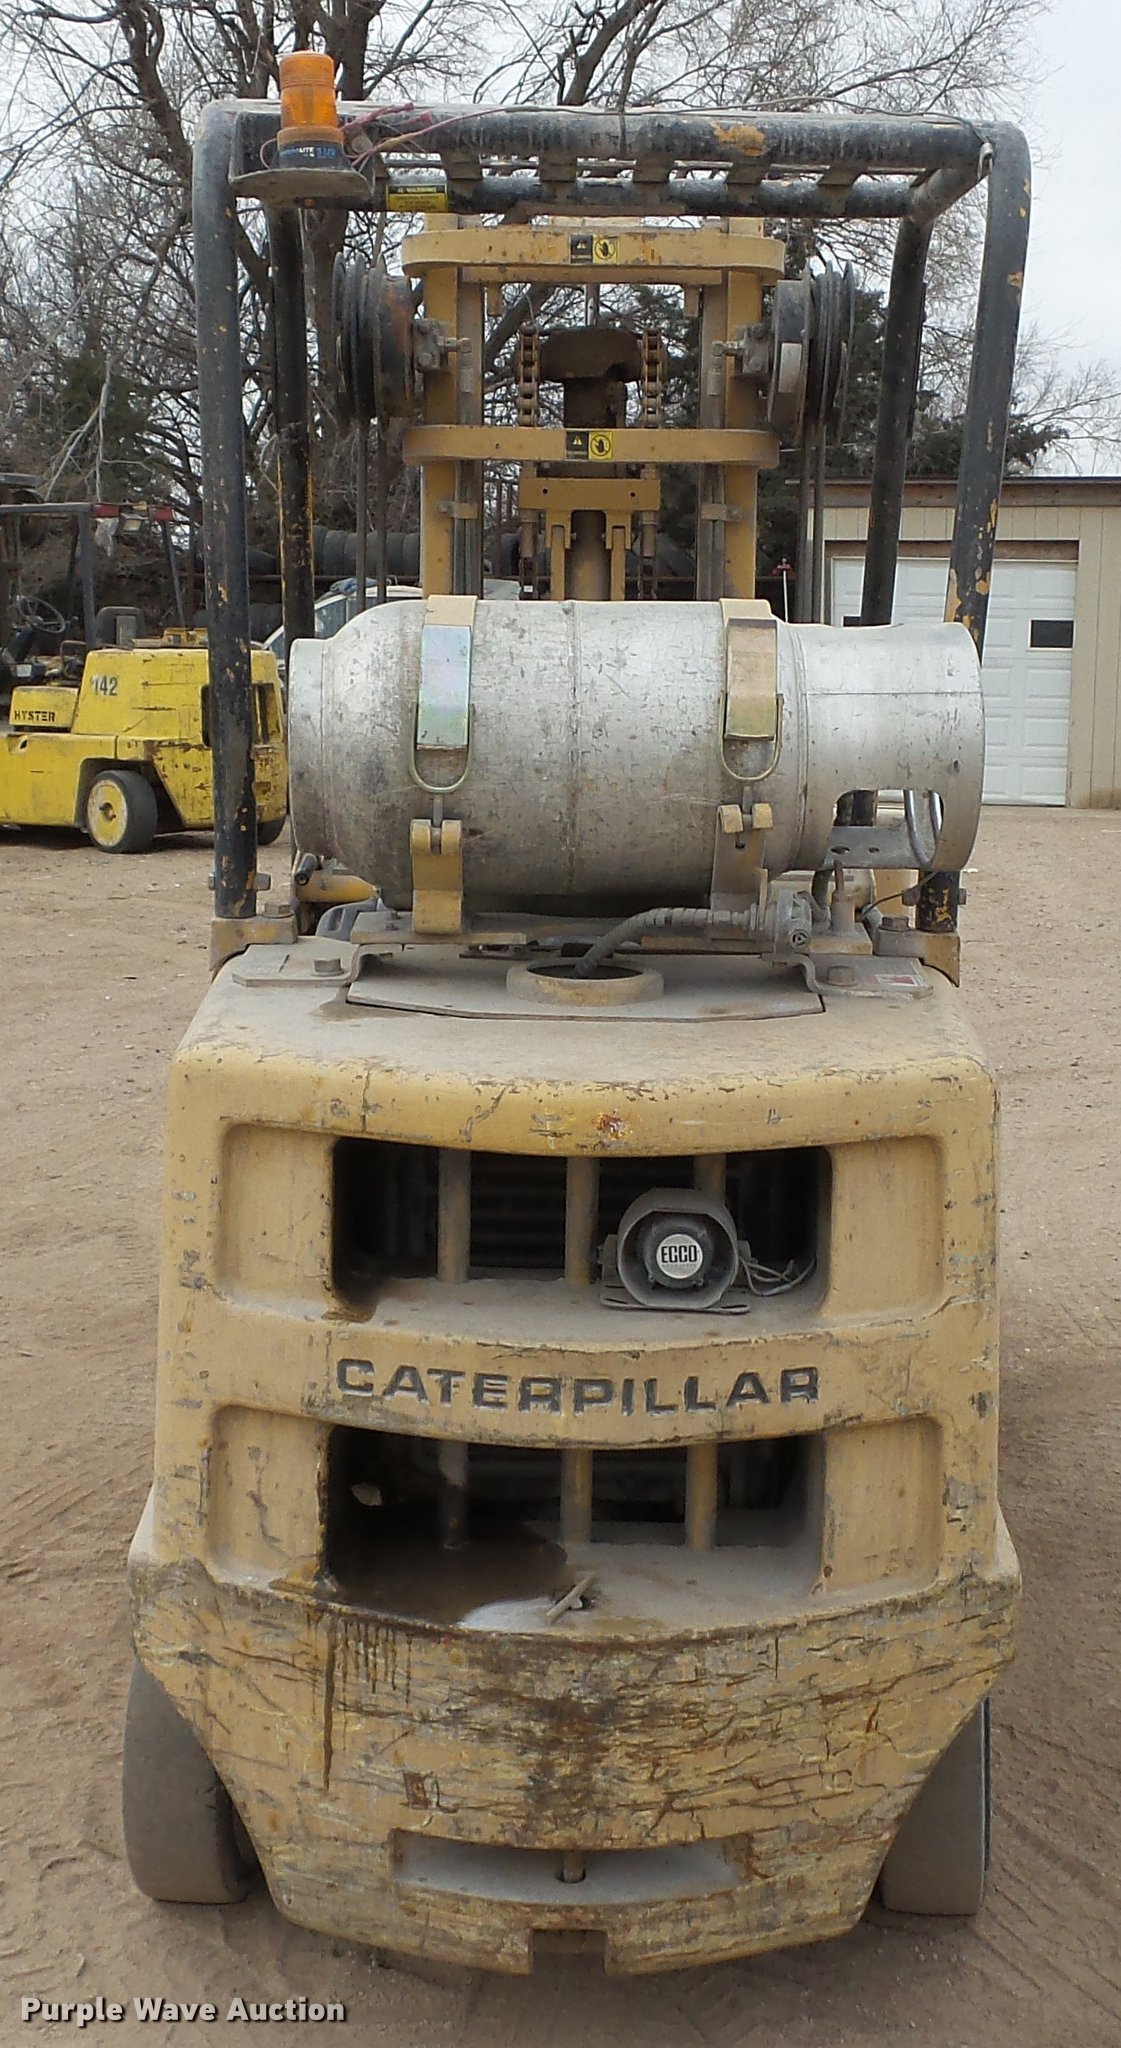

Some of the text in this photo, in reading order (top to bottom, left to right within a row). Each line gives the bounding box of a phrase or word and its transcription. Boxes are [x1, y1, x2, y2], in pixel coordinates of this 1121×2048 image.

[92, 676, 118, 697] 142
[13, 710, 56, 723] HYSTER
[661, 1244, 698, 1264] ECCO
[336, 1357, 820, 1417] CATERPILLAR
